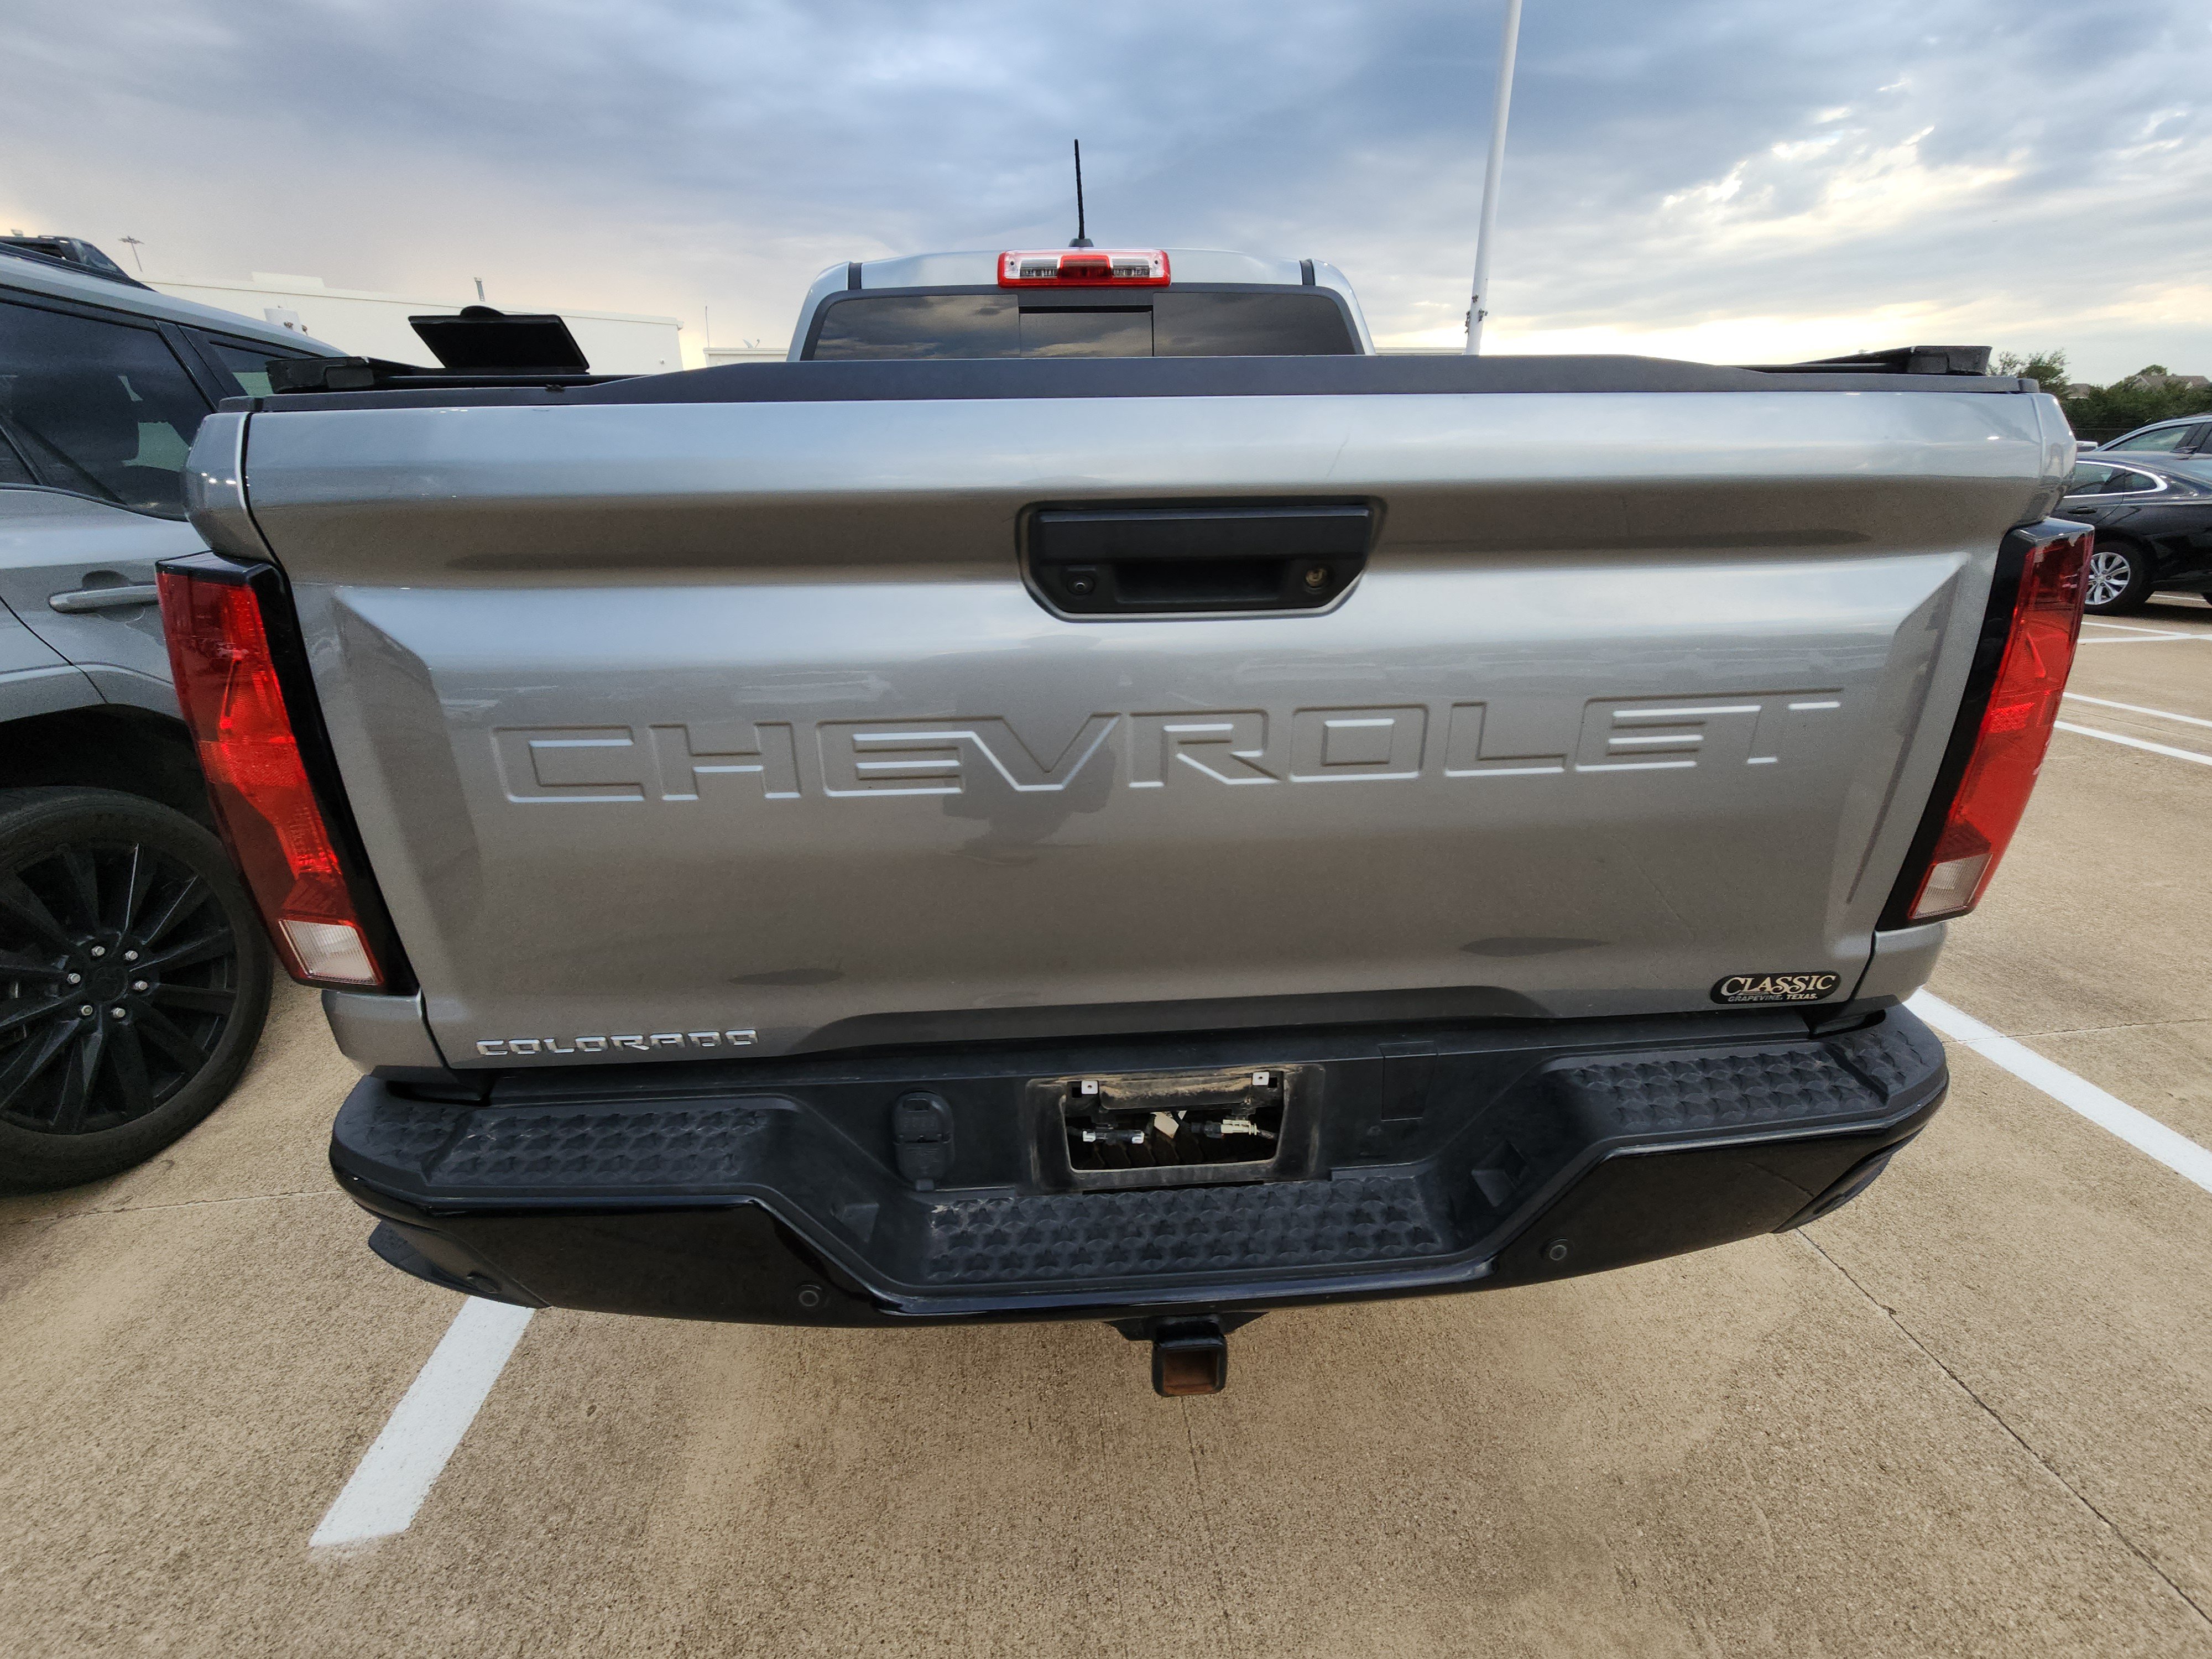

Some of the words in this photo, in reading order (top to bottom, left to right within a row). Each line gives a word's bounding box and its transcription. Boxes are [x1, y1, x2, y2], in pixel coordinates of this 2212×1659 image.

[489, 687, 1845, 803] CHEVROLET
[1720, 975, 1837, 996] CLASSIC
[476, 1029, 758, 1056] COLORADO
